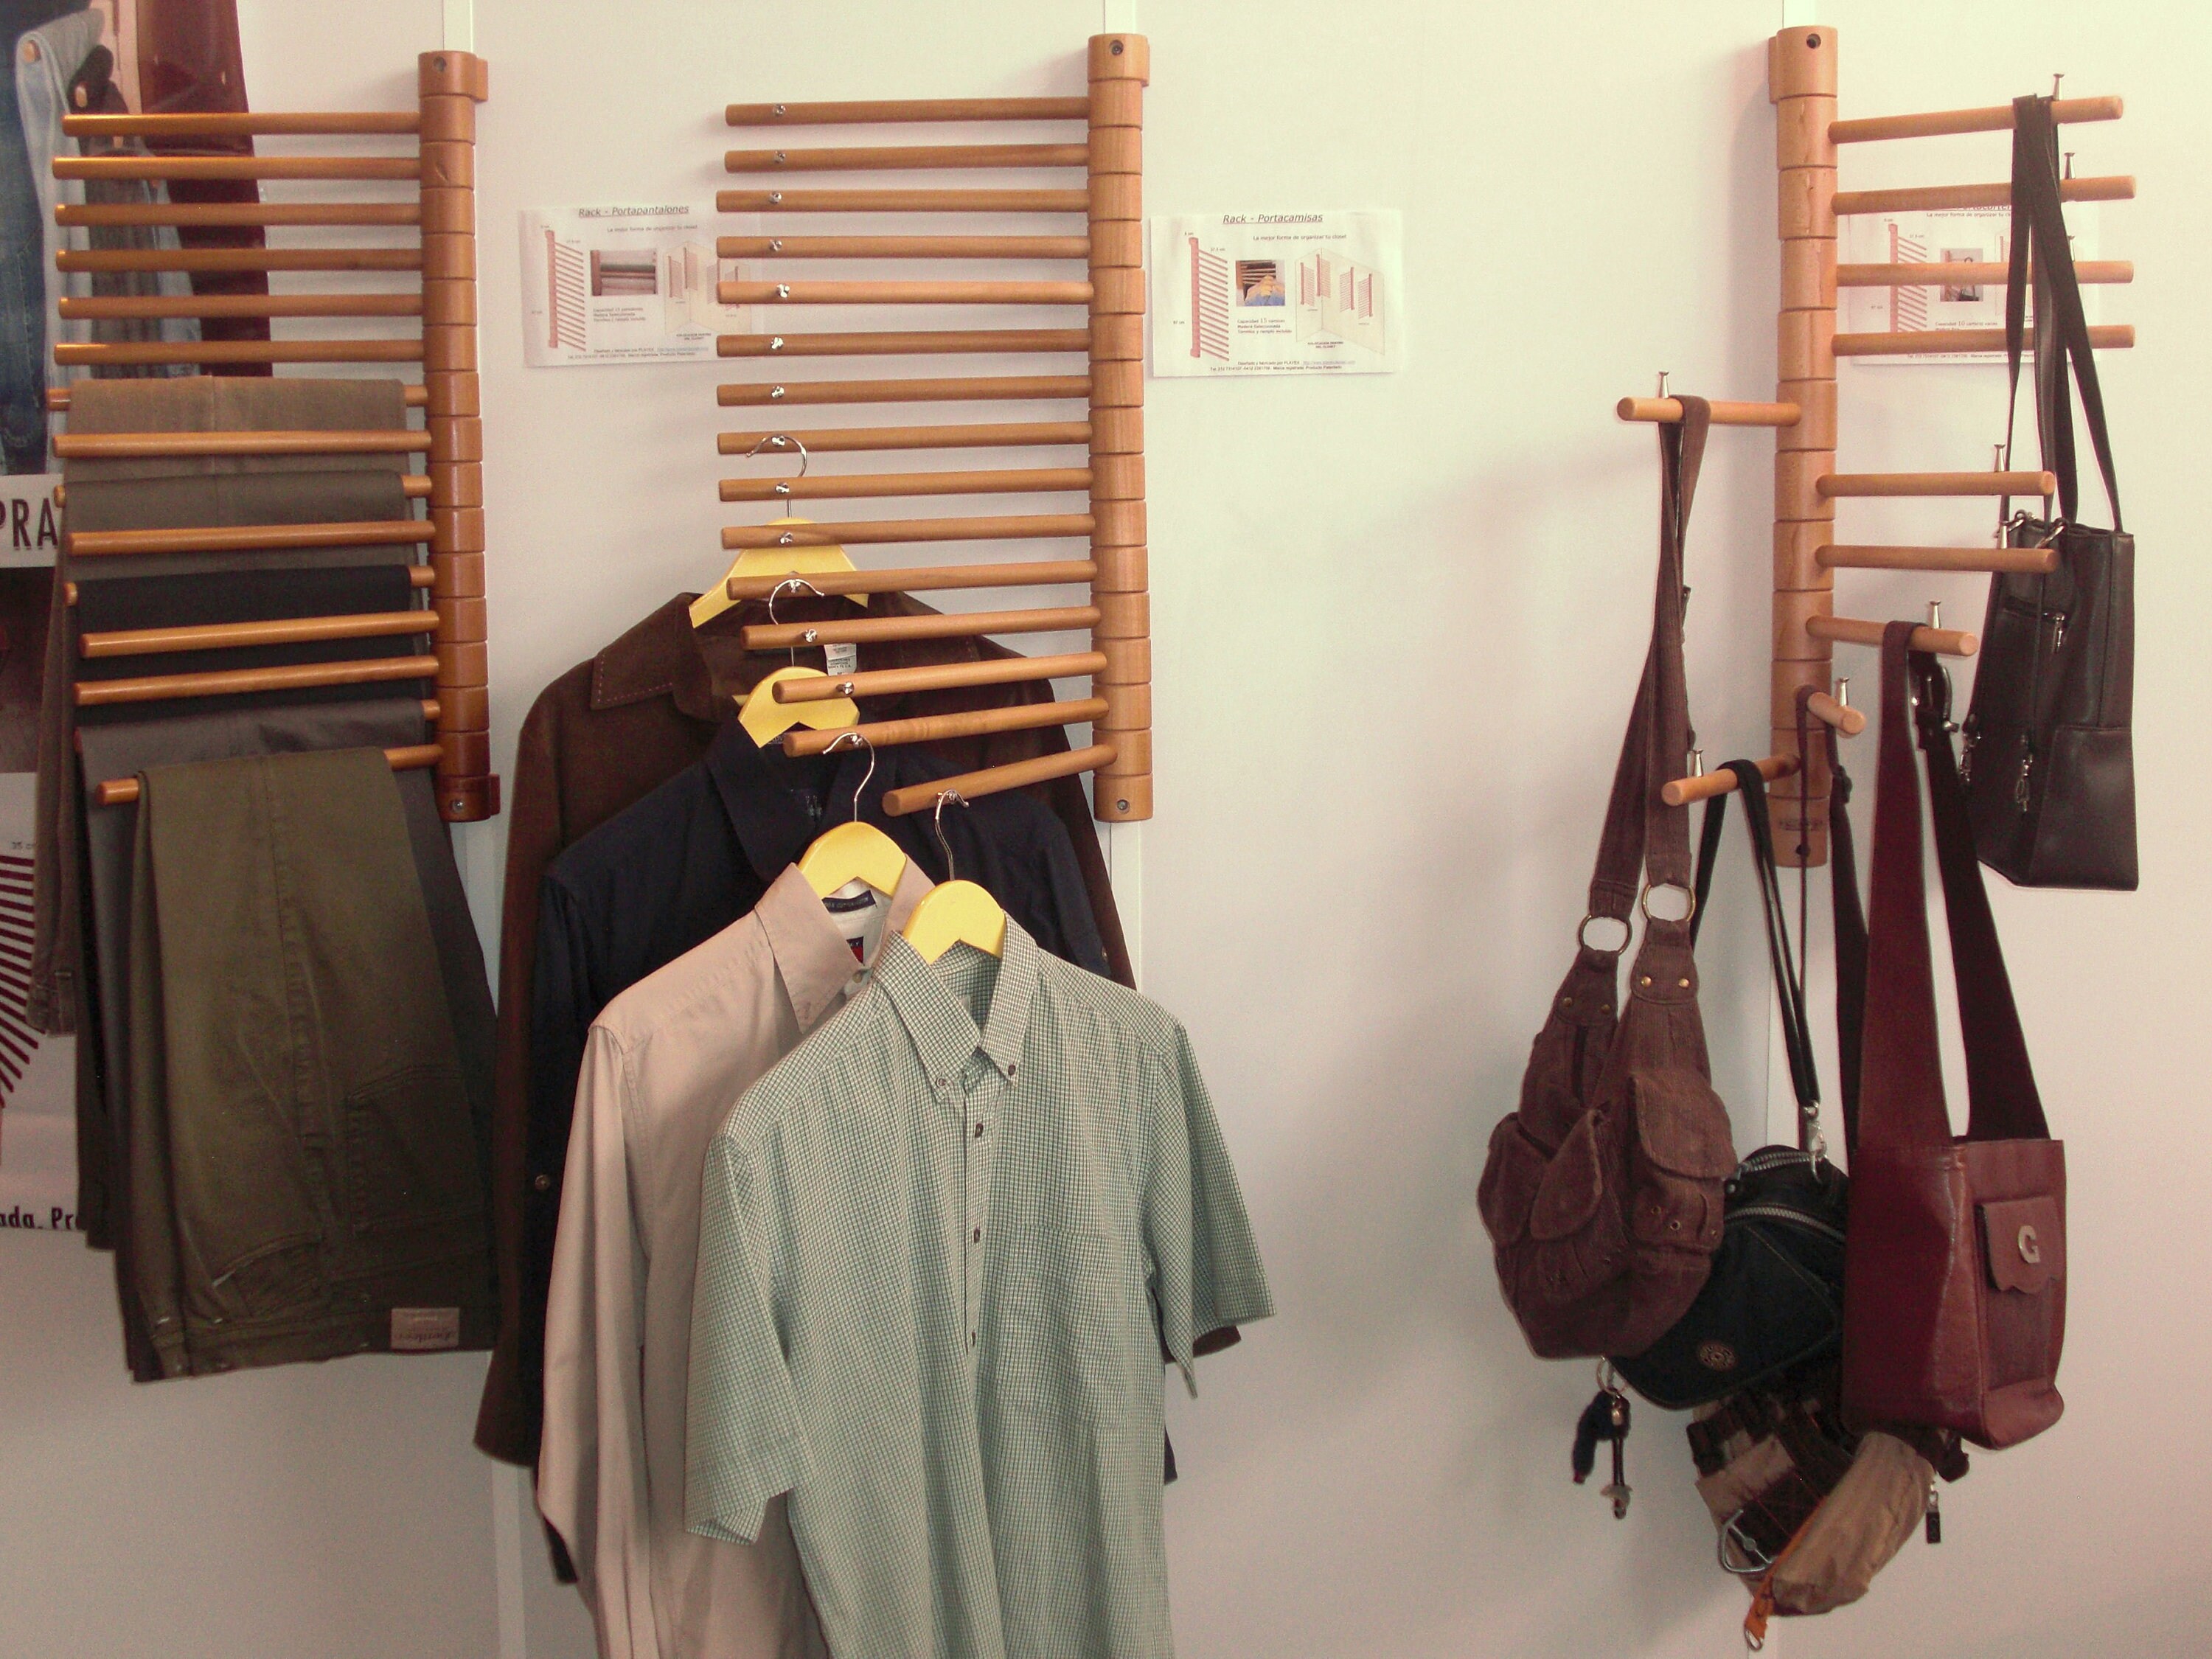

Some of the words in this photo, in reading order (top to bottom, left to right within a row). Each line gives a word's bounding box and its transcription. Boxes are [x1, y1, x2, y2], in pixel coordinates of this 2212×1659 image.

[578, 208, 602, 218] Rack
[611, 205, 689, 217] Portapantalones
[1222, 214, 1247, 223] Rack
[1257, 213, 1324, 223] Portacamisas
[2017, 1225, 2041, 1264] G
